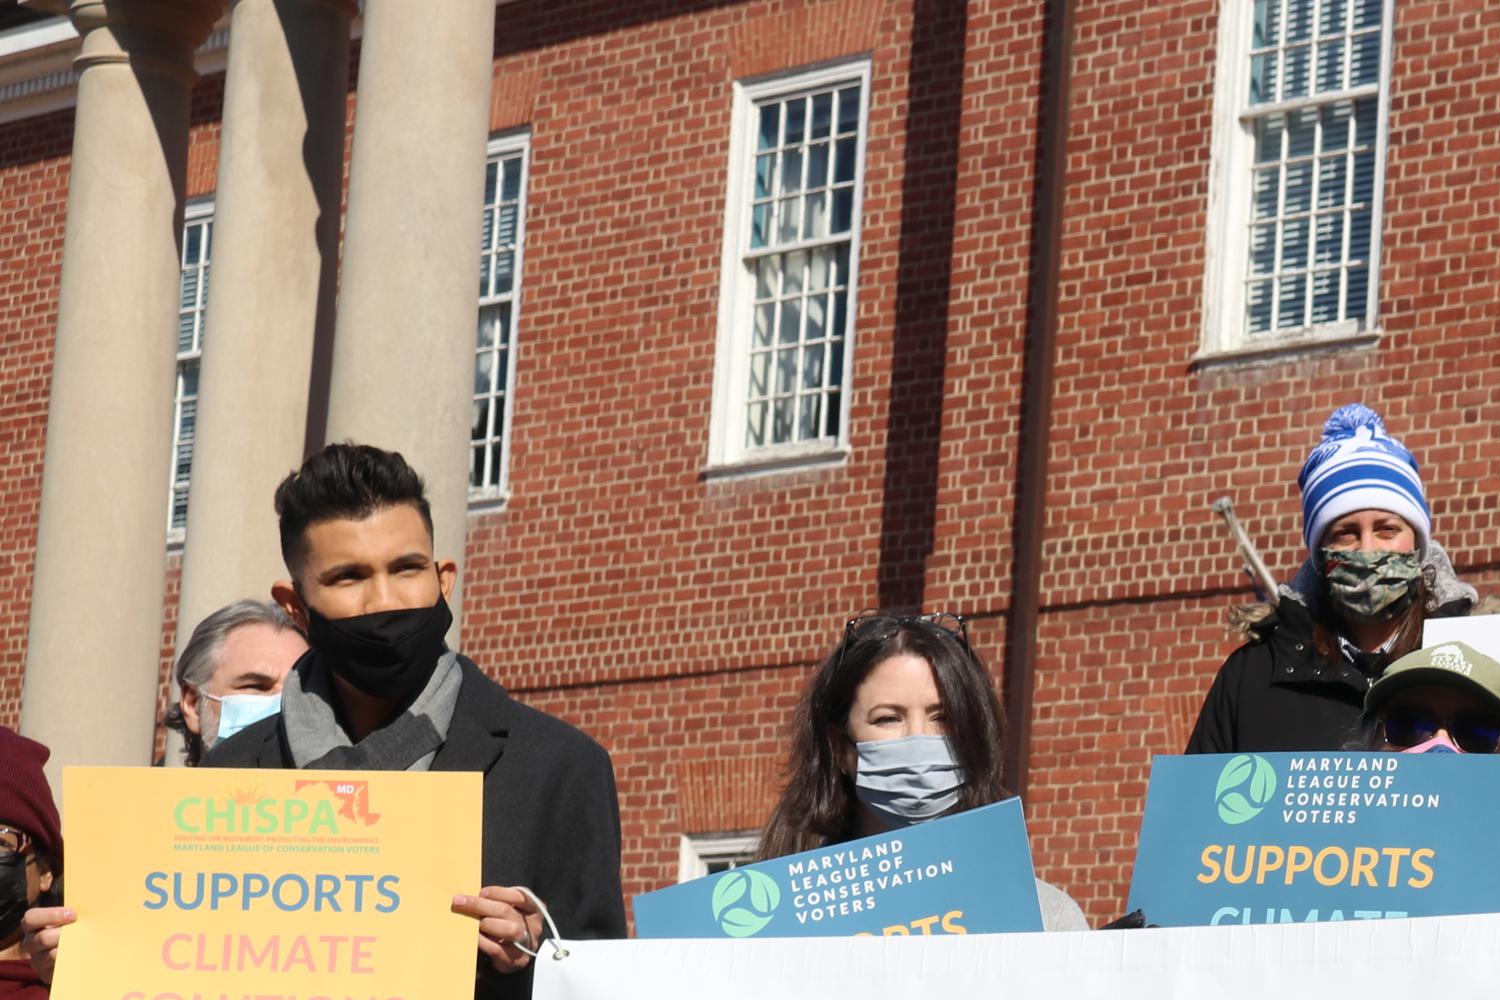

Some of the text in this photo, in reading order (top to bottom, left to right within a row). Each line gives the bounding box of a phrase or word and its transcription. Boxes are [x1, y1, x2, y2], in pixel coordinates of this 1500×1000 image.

[1289, 758, 1399, 772] MARYLAND
[336, 785, 354, 794] MD
[1286, 775, 1395, 789] LEAGUE OF
[1284, 792, 1440, 808] CONSERVATION
[1282, 810, 1357, 824] VOTERS
[174, 843, 380, 854] MARYLAND LEAGUE OF CONSERVATION VOTERS
[788, 840, 904, 876] MARYLAND
[790, 856, 904, 892] LEAGUE OF
[1196, 844, 1436, 888] SUPPORTS
[143, 871, 401, 914] SUPPORTS
[793, 860, 954, 909] CONSERVATION
[796, 896, 876, 925] VOTERS
[161, 933, 377, 974] CLIMATE
